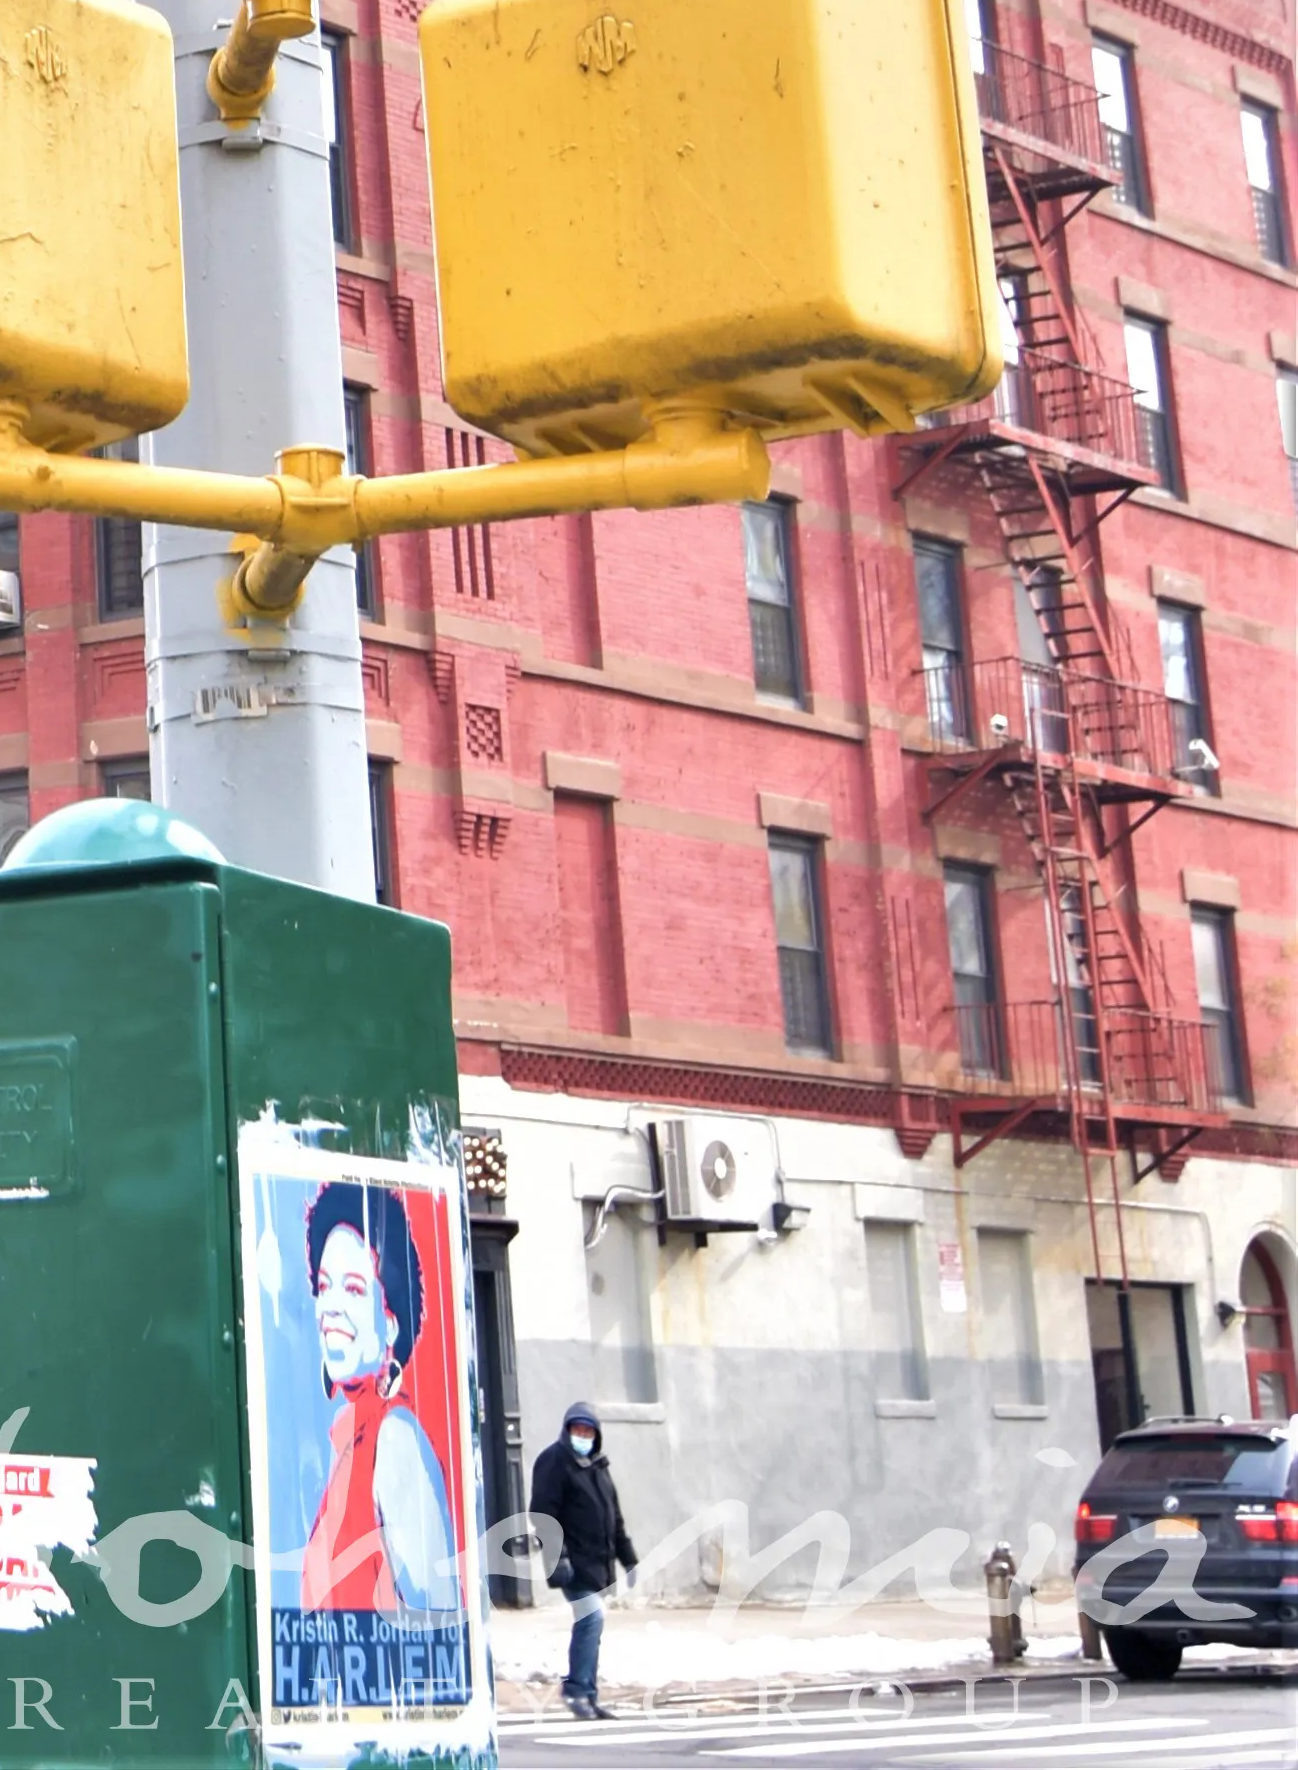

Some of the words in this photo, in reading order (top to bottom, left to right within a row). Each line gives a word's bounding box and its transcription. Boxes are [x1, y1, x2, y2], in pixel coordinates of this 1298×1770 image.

[274, 1612, 339, 1642] Kristin
[343, 1612, 365, 1642] R.
[369, 1612, 435, 1642] Jordan
